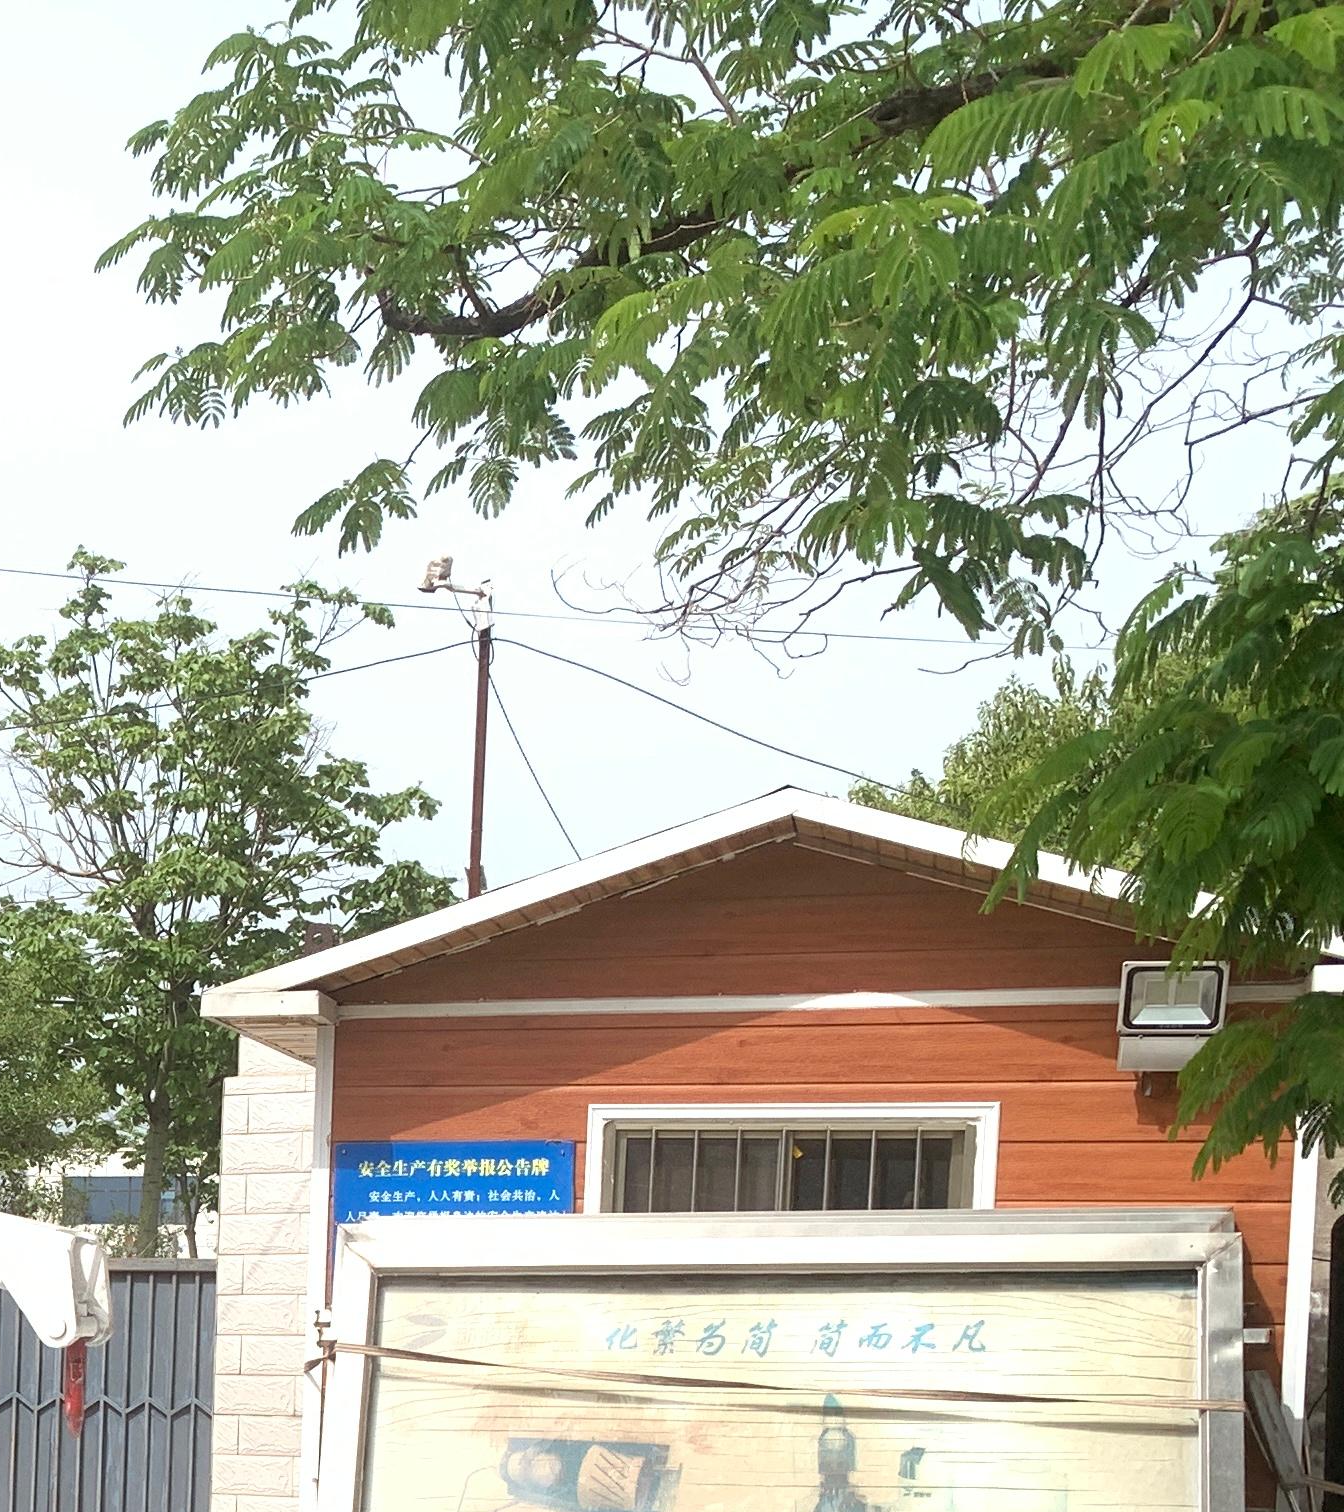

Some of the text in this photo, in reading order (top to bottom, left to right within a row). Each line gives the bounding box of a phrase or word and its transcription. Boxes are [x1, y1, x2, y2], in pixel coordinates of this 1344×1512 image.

[358, 1158, 551, 1178] 安全生产有奖举报公告牌
[605, 1318, 987, 1358] 化繁为简 简而不凡
